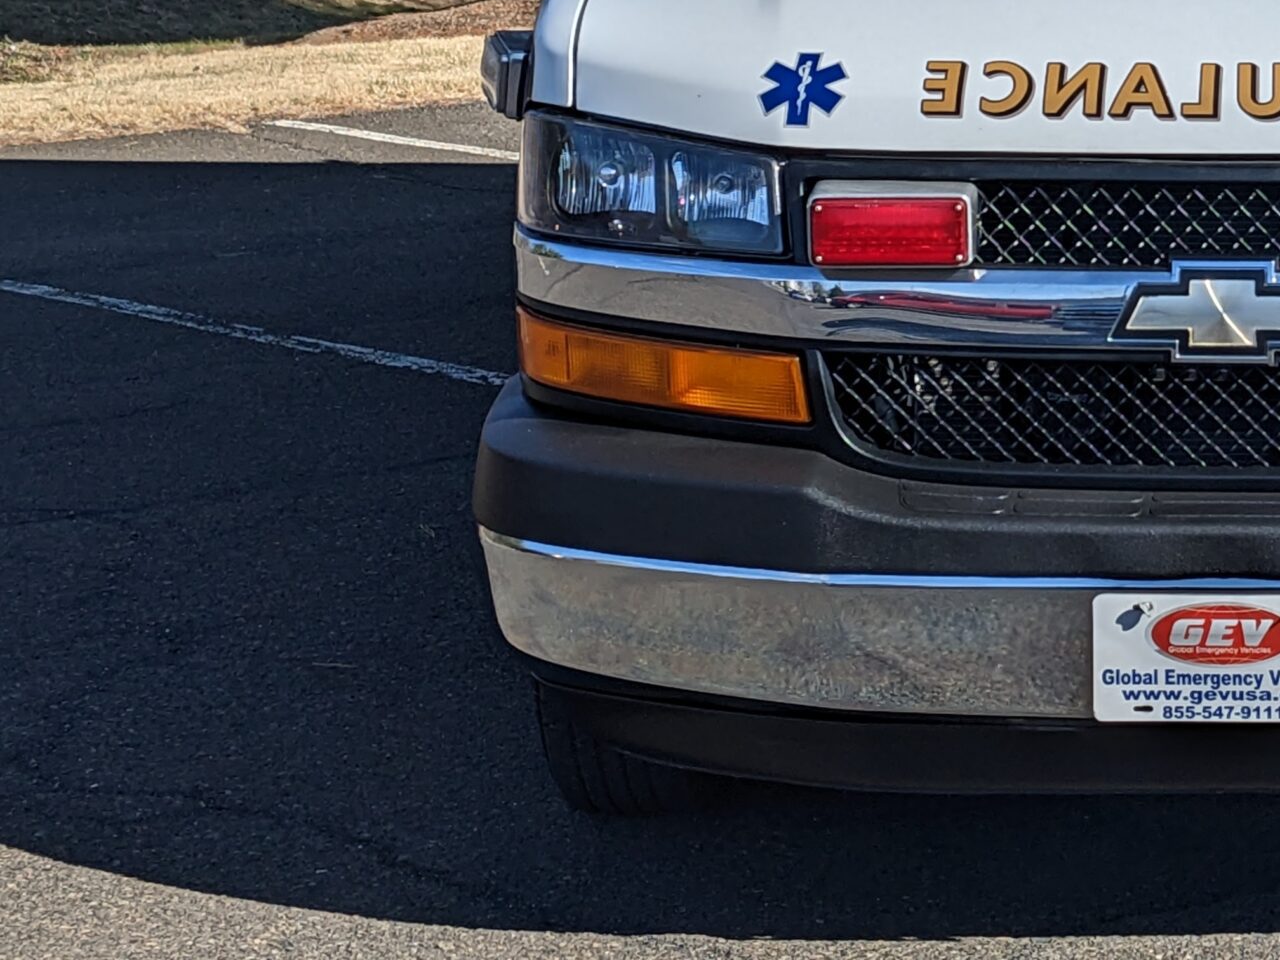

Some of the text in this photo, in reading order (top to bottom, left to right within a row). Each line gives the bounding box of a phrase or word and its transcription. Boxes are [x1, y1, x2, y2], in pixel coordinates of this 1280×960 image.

[1169, 618, 1273, 646] GEV
[1102, 669, 1158, 686] Global
[1164, 670, 1263, 689] Emergency
